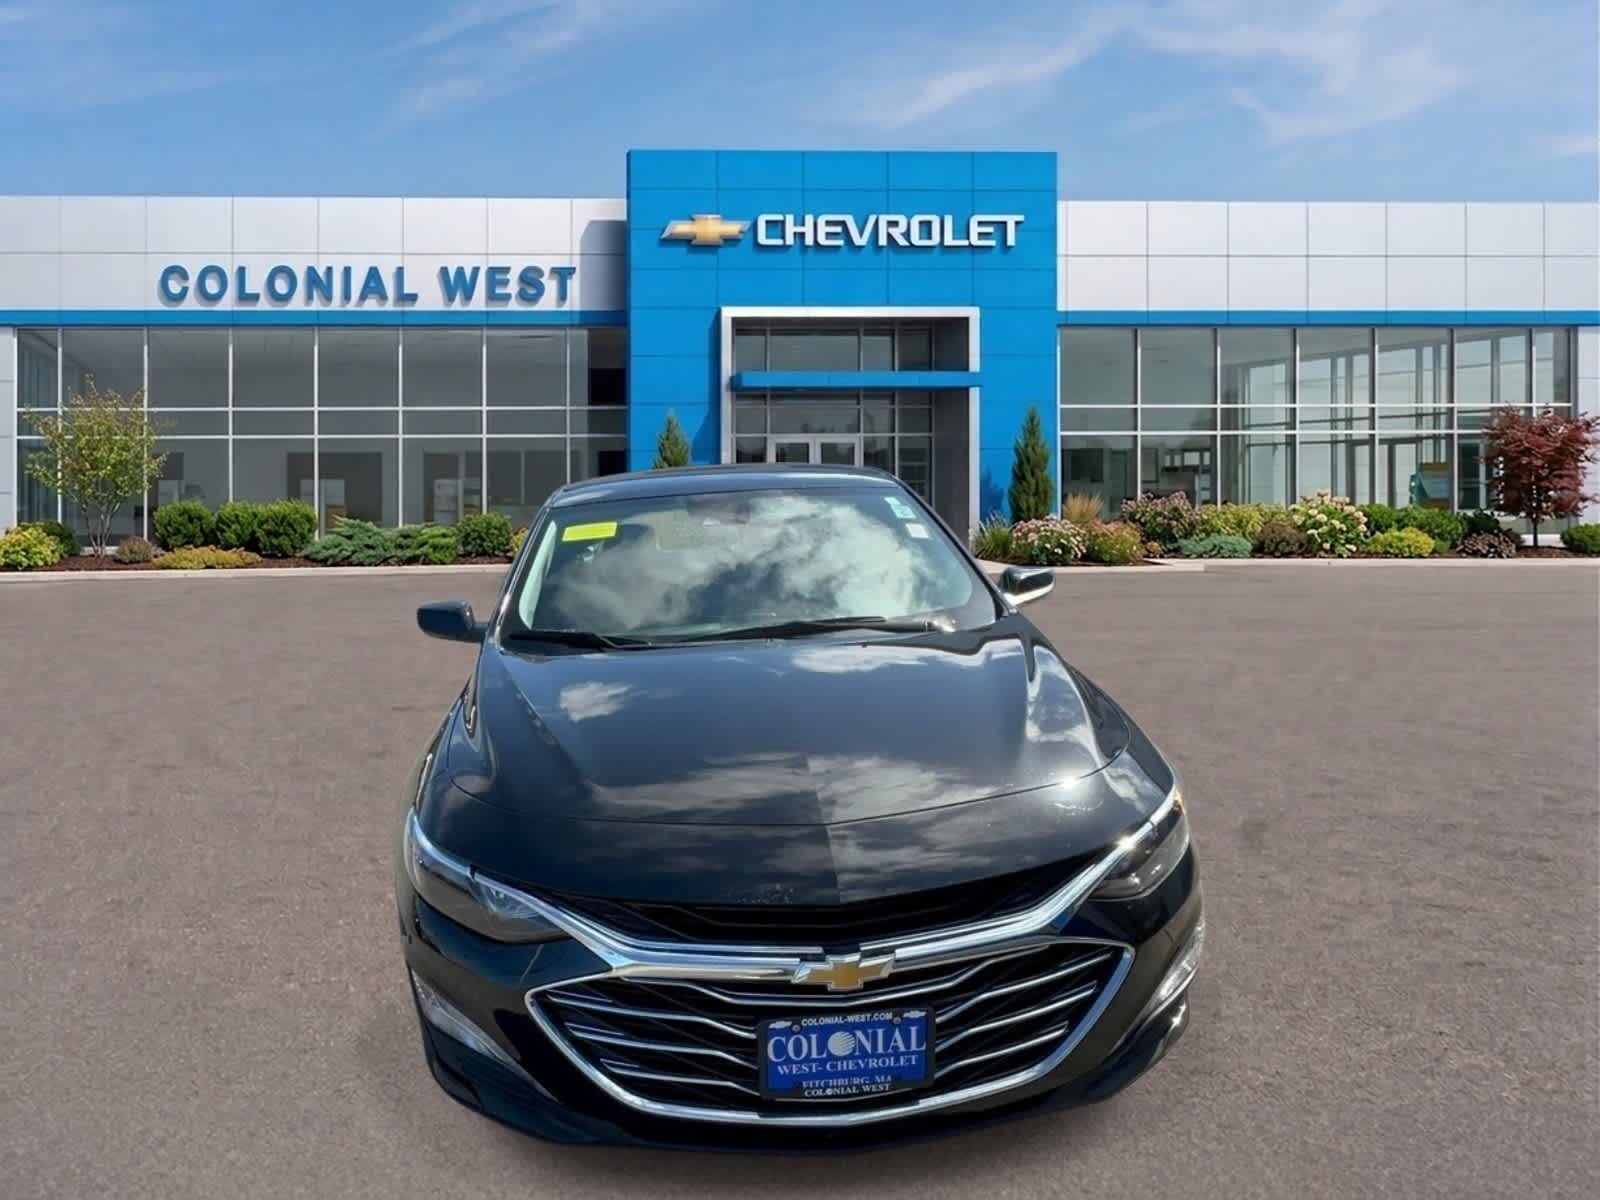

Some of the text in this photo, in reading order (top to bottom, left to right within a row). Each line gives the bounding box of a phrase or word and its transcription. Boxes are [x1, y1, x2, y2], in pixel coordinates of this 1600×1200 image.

[756, 214, 1025, 247] CHEVROLET
[160, 264, 577, 302] COLONIAL WEST
[801, 1012, 893, 1026] COLONIAL-WEST.COM
[767, 1025, 927, 1062] COLONIAL
[826, 1055, 919, 1072] CHEVROLET
[804, 1083, 891, 1097] COLONIAL WEST
